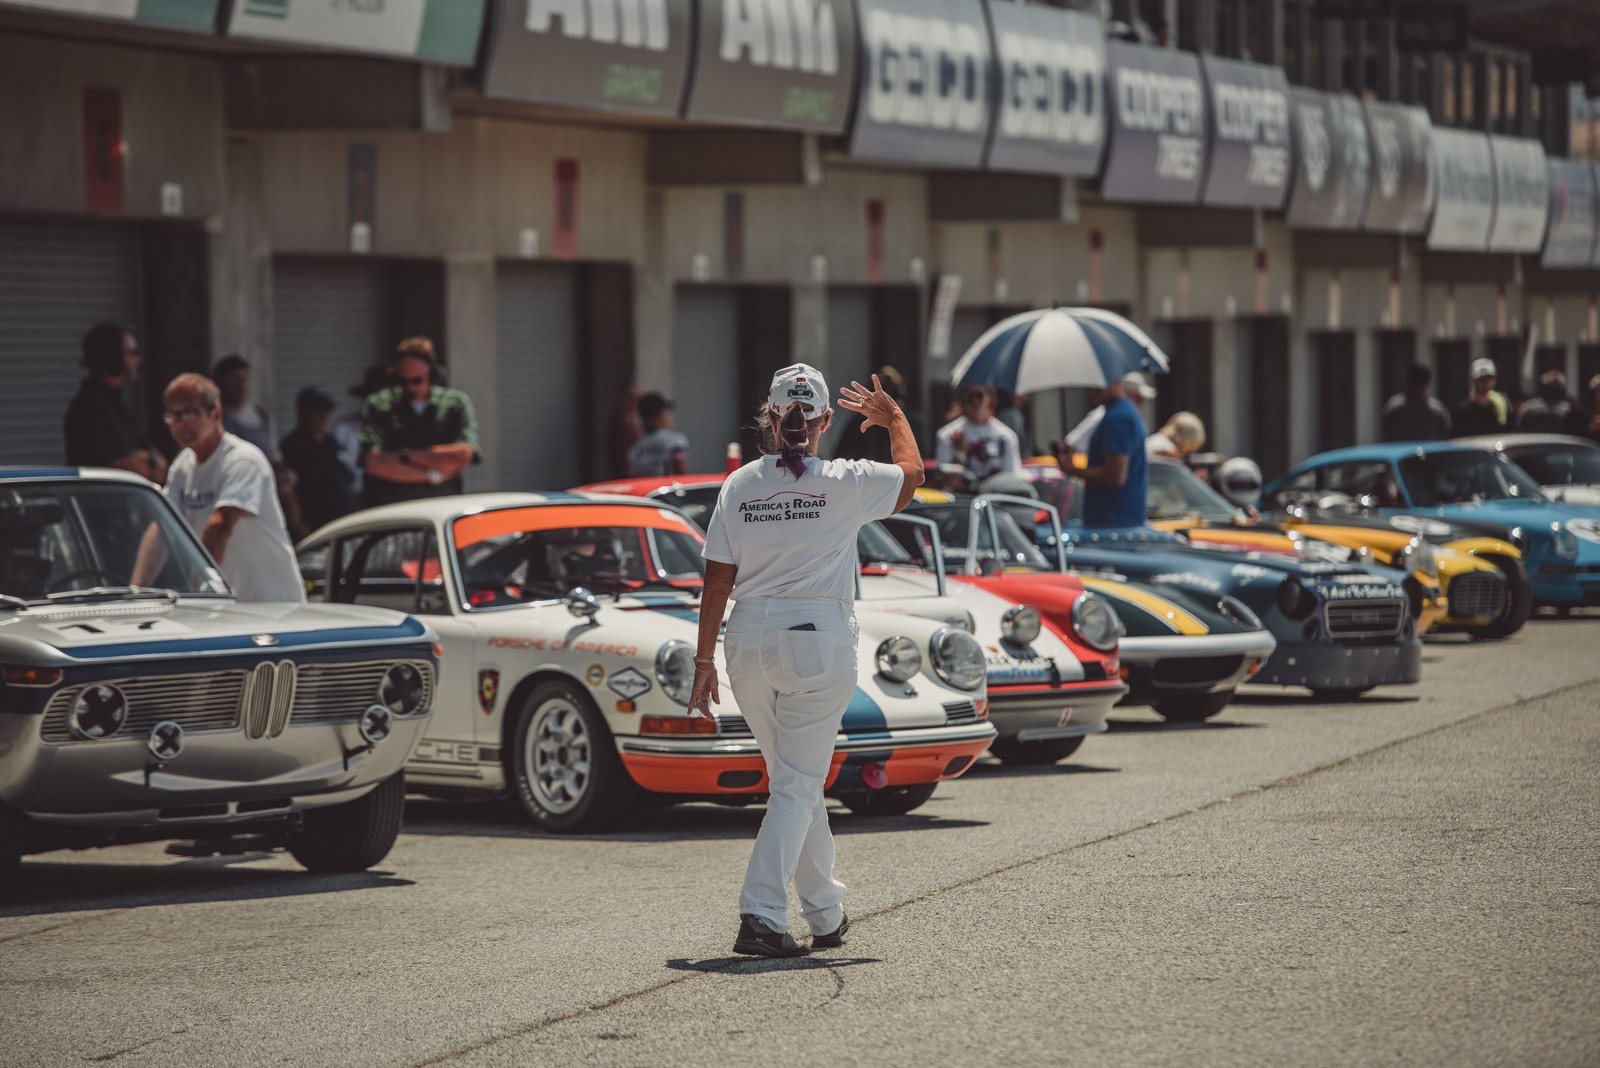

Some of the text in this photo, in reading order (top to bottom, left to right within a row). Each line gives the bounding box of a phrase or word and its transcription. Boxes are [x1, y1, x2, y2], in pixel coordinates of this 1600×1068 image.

[866, 9, 987, 131] GEICO
[1001, 33, 1099, 145] GEICO
[1117, 68, 1201, 135] COOPER
[1214, 82, 1287, 144] COOPER
[744, 510, 820, 522] RACING SERIES
[793, 498, 826, 508] ROAD
[487, 636, 638, 656] PORSCHE OF AMERICA
